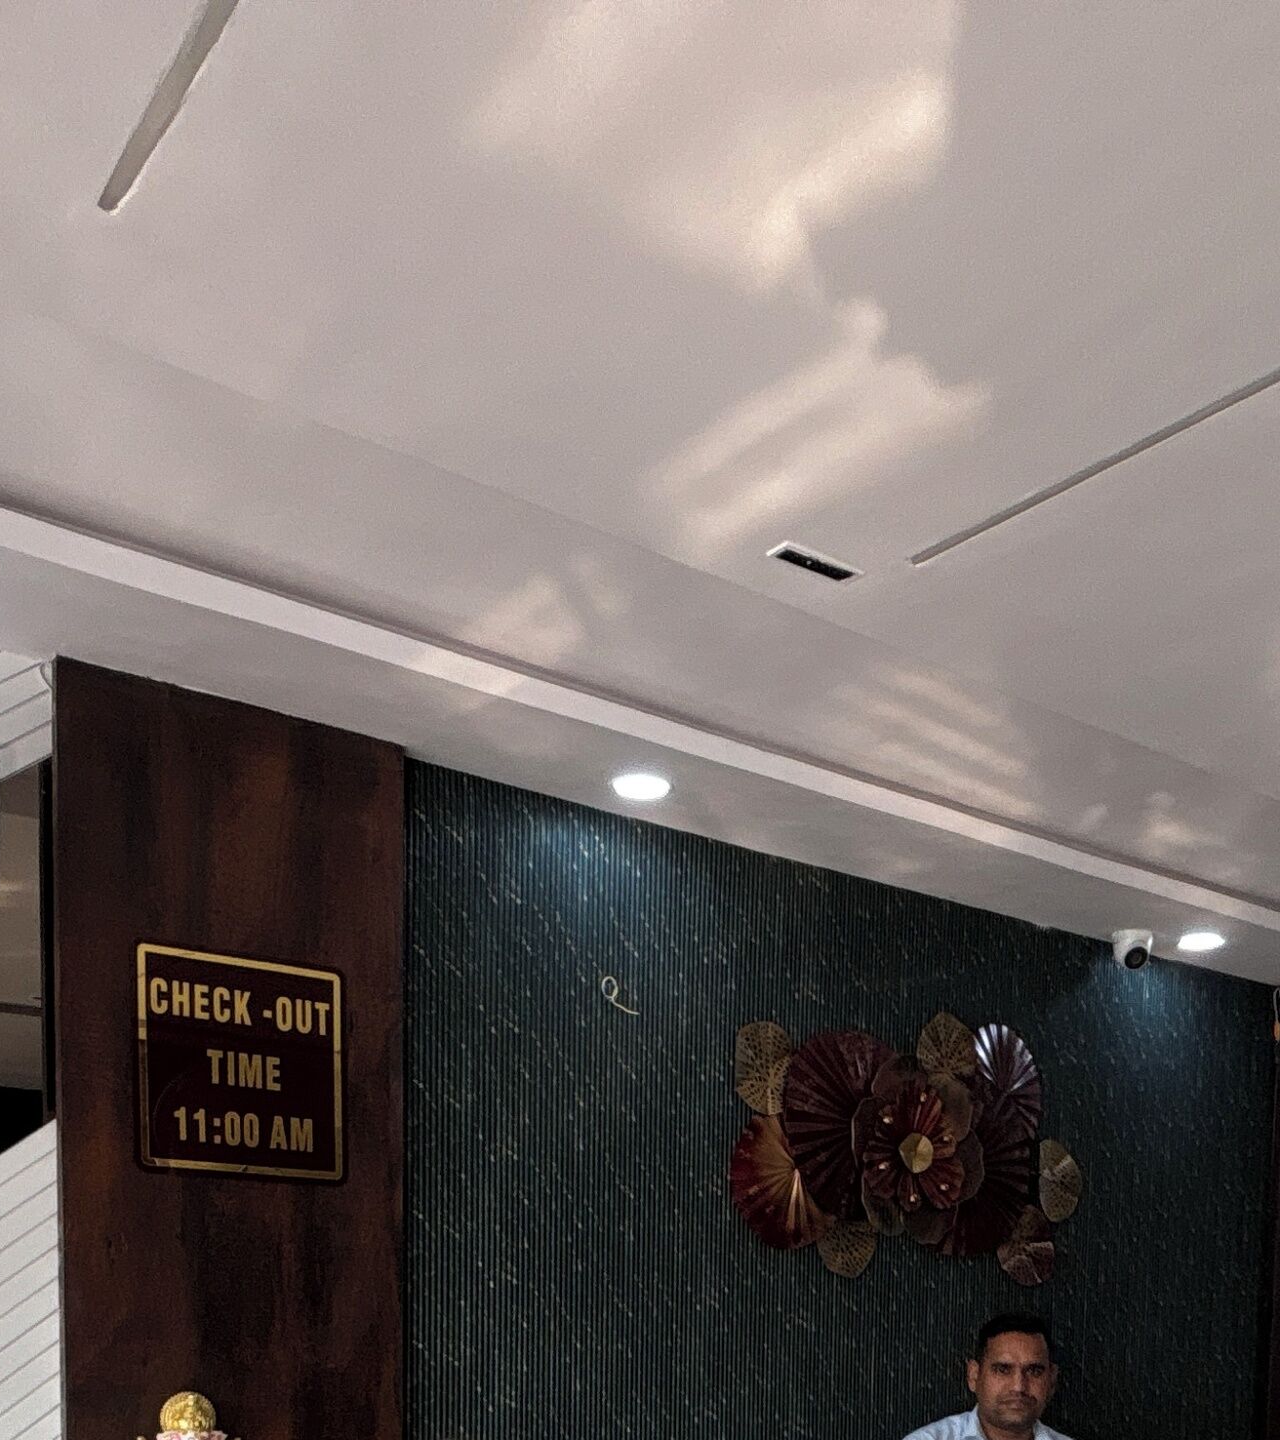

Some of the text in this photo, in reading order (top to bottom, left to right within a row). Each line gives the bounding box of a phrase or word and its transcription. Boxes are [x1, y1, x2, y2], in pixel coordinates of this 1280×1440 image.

[149, 976, 252, 1026] CHECK
[206, 1048, 282, 1092] TIME
[173, 1105, 314, 1153] 11:00 AM
